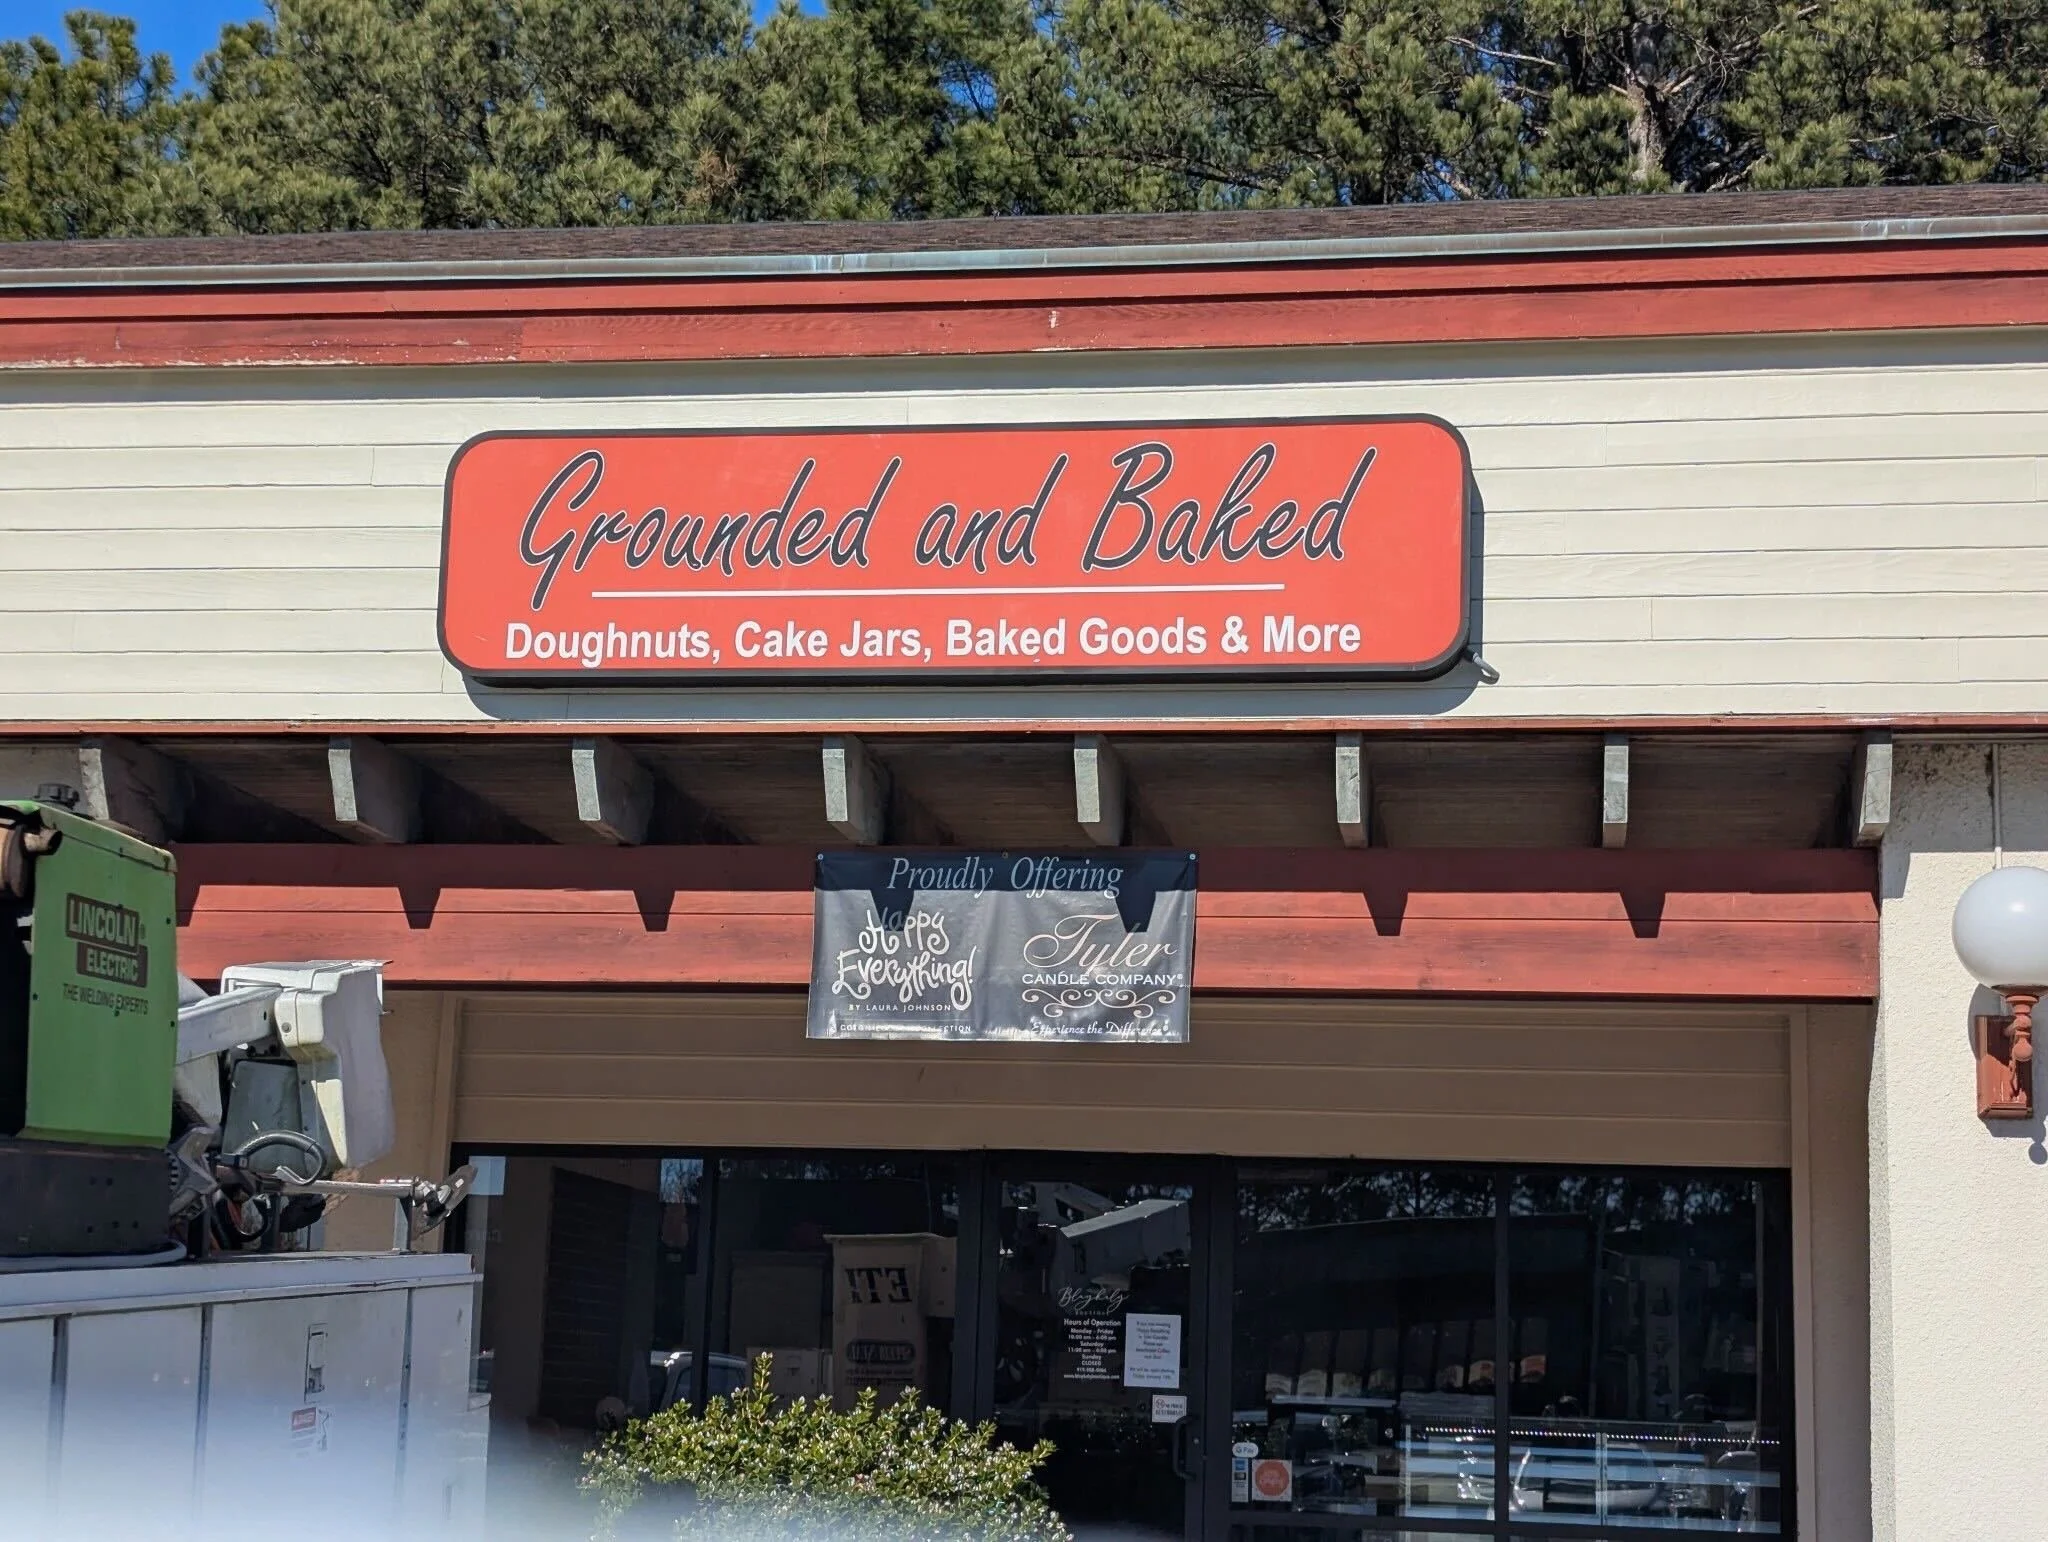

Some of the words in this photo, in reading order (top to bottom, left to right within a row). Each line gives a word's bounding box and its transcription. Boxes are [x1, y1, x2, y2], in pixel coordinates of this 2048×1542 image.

[519, 449, 902, 611] Grounded
[915, 452, 1069, 574] and
[1081, 441, 1378, 573] Baked
[505, 622, 721, 669] Doughnuts,
[734, 620, 828, 658] Cake
[840, 619, 931, 663] Jars,
[947, 618, 1066, 656] Baked
[1079, 616, 1207, 656] Goods
[1221, 615, 1249, 654] &
[1262, 615, 1361, 654] More
[887, 857, 994, 898] Proudly
[1010, 856, 1124, 899] Offering
[69, 898, 136, 947] LINCOLN
[858, 906, 950, 955] Happy
[87, 948, 138, 981] ELECTRIC
[1023, 913, 1178, 981] Tyler
[63, 982, 78, 1001] THE
[80, 987, 114, 1008] WELDING
[115, 994, 148, 1015] EXPERTS
[832, 945, 977, 1010] Everything!
[1022, 973, 1090, 985] CANDLE
[903, 1004, 951, 1012] JOHNSON
[1086, 1021, 1103, 1034] the
[1064, 1318, 1082, 1326] Hours
[1083, 1318, 1090, 1326] of
[1091, 1318, 1122, 1327] Operation
